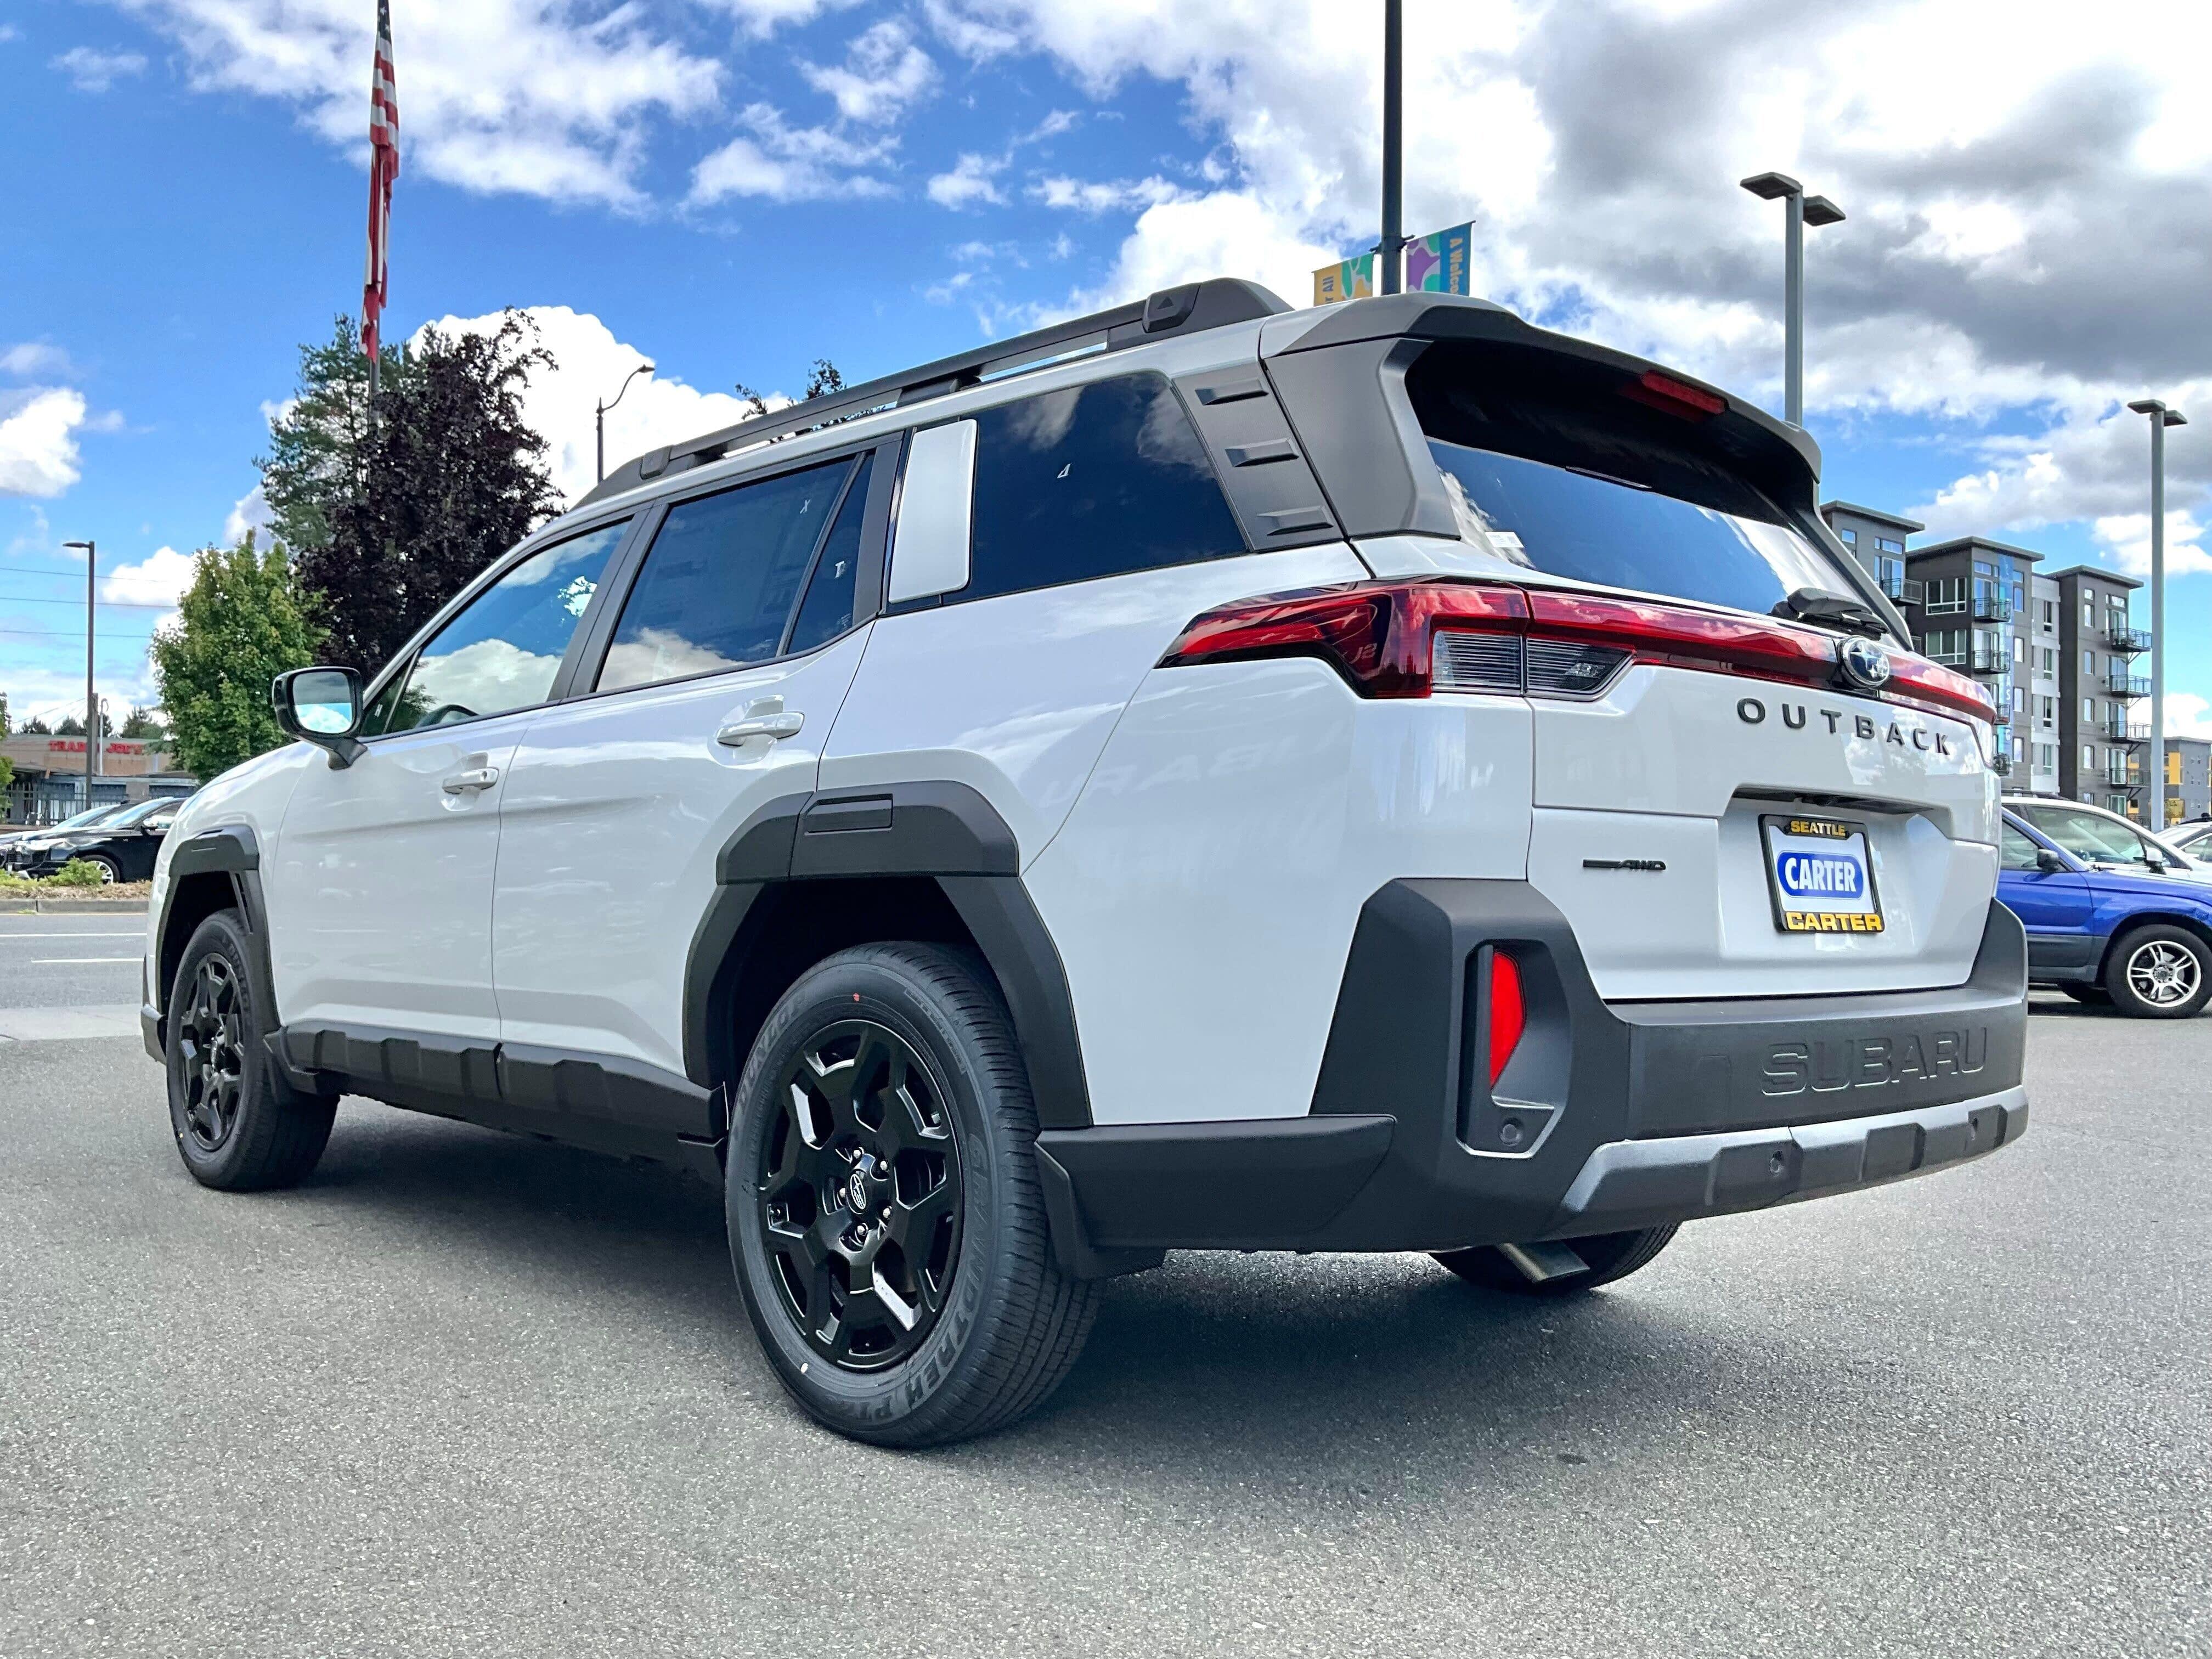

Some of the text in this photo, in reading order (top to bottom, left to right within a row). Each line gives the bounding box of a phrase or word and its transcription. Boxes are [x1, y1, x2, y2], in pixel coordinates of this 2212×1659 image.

[1736, 697, 1951, 755] OUTBACK
[1790, 820, 1847, 837] SEATTLE
[1785, 857, 1857, 892] CARTER
[1786, 912, 1882, 931] CARTER
[1760, 1026, 1987, 1096] SUBARU
